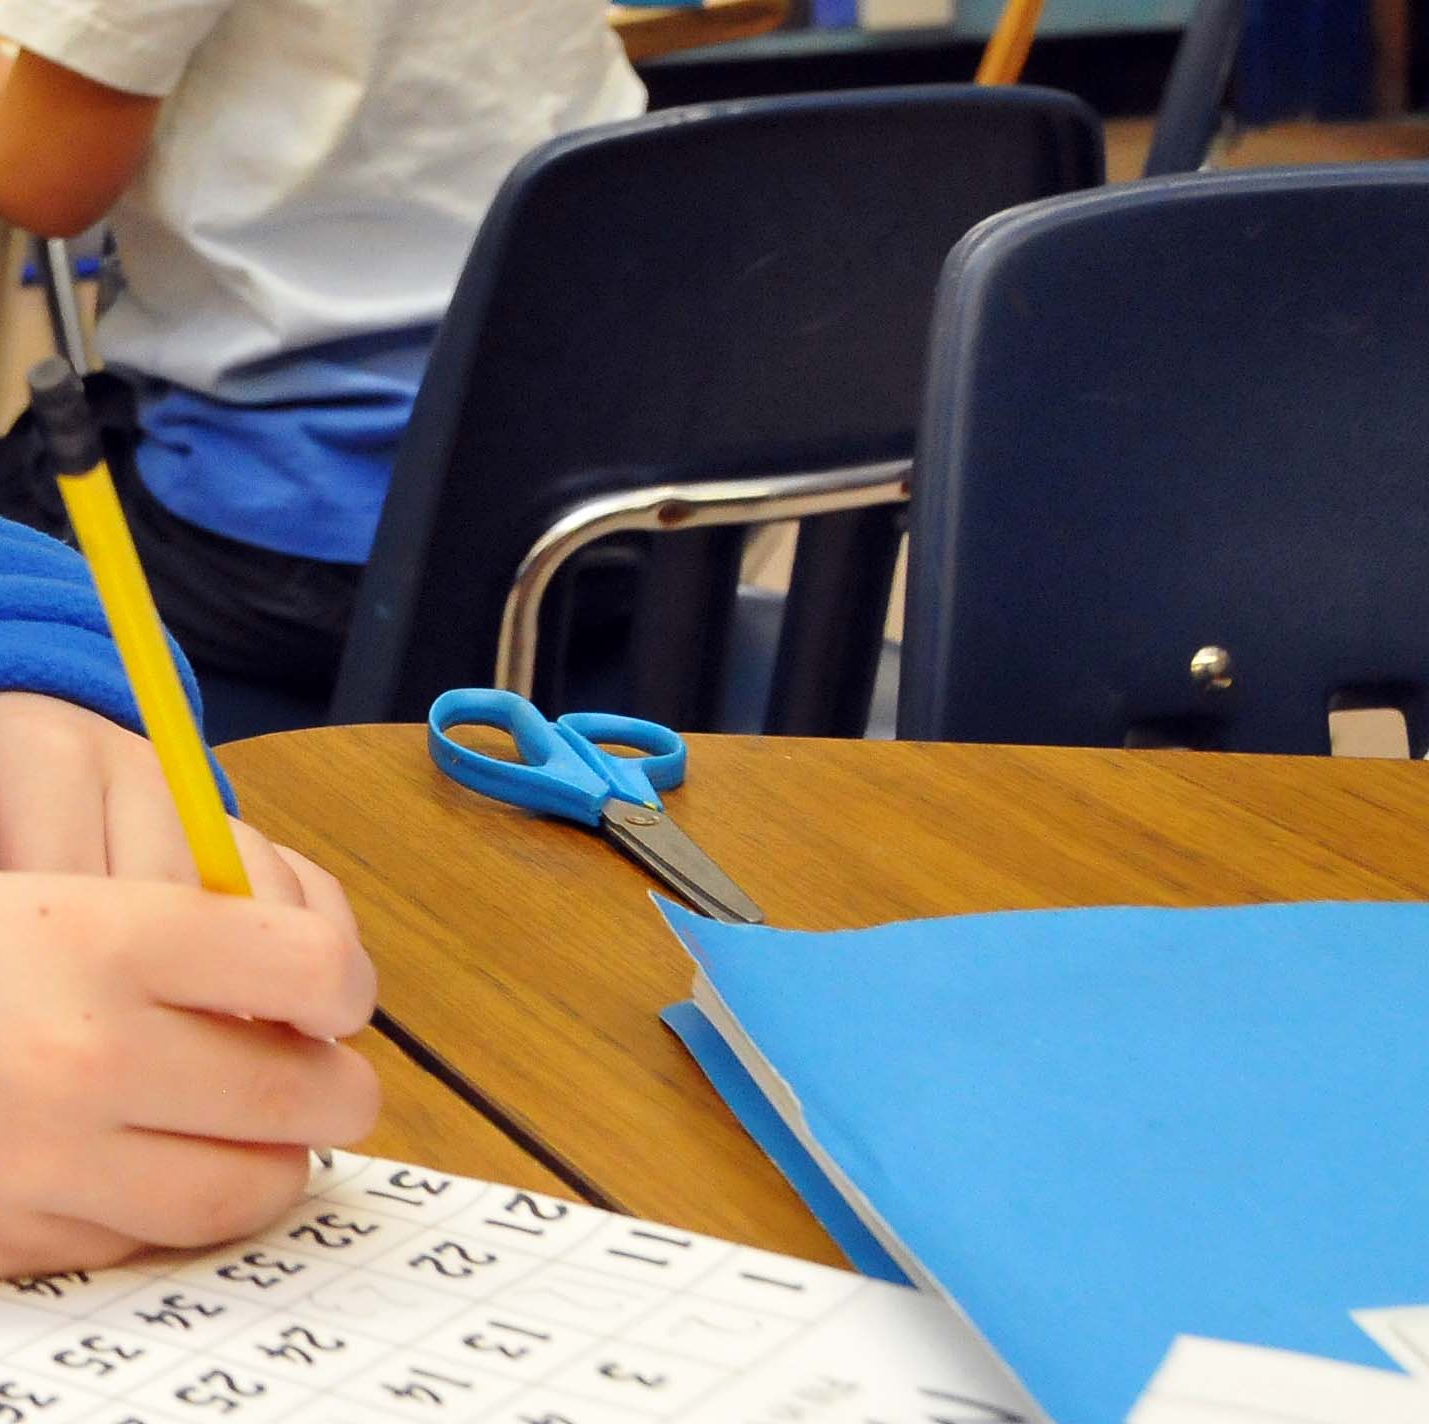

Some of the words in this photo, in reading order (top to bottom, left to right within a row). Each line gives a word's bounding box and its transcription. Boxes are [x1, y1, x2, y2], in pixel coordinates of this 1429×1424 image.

[366, 1170, 450, 1207] 31
[290, 1213, 378, 1249] 32
[484, 1194, 568, 1236] 21
[408, 1242, 497, 1280] 22
[607, 1230, 692, 1267] 11
[216, 1253, 305, 1289] 33
[135, 1294, 225, 1330] 34
[52, 1336, 143, 1376] 35
[257, 1325, 346, 1366] 24
[462, 1321, 551, 1360] 13
[174, 1369, 266, 1413] 25
[380, 1367, 471, 1407] 14
[598, 1362, 665, 1388] 3
